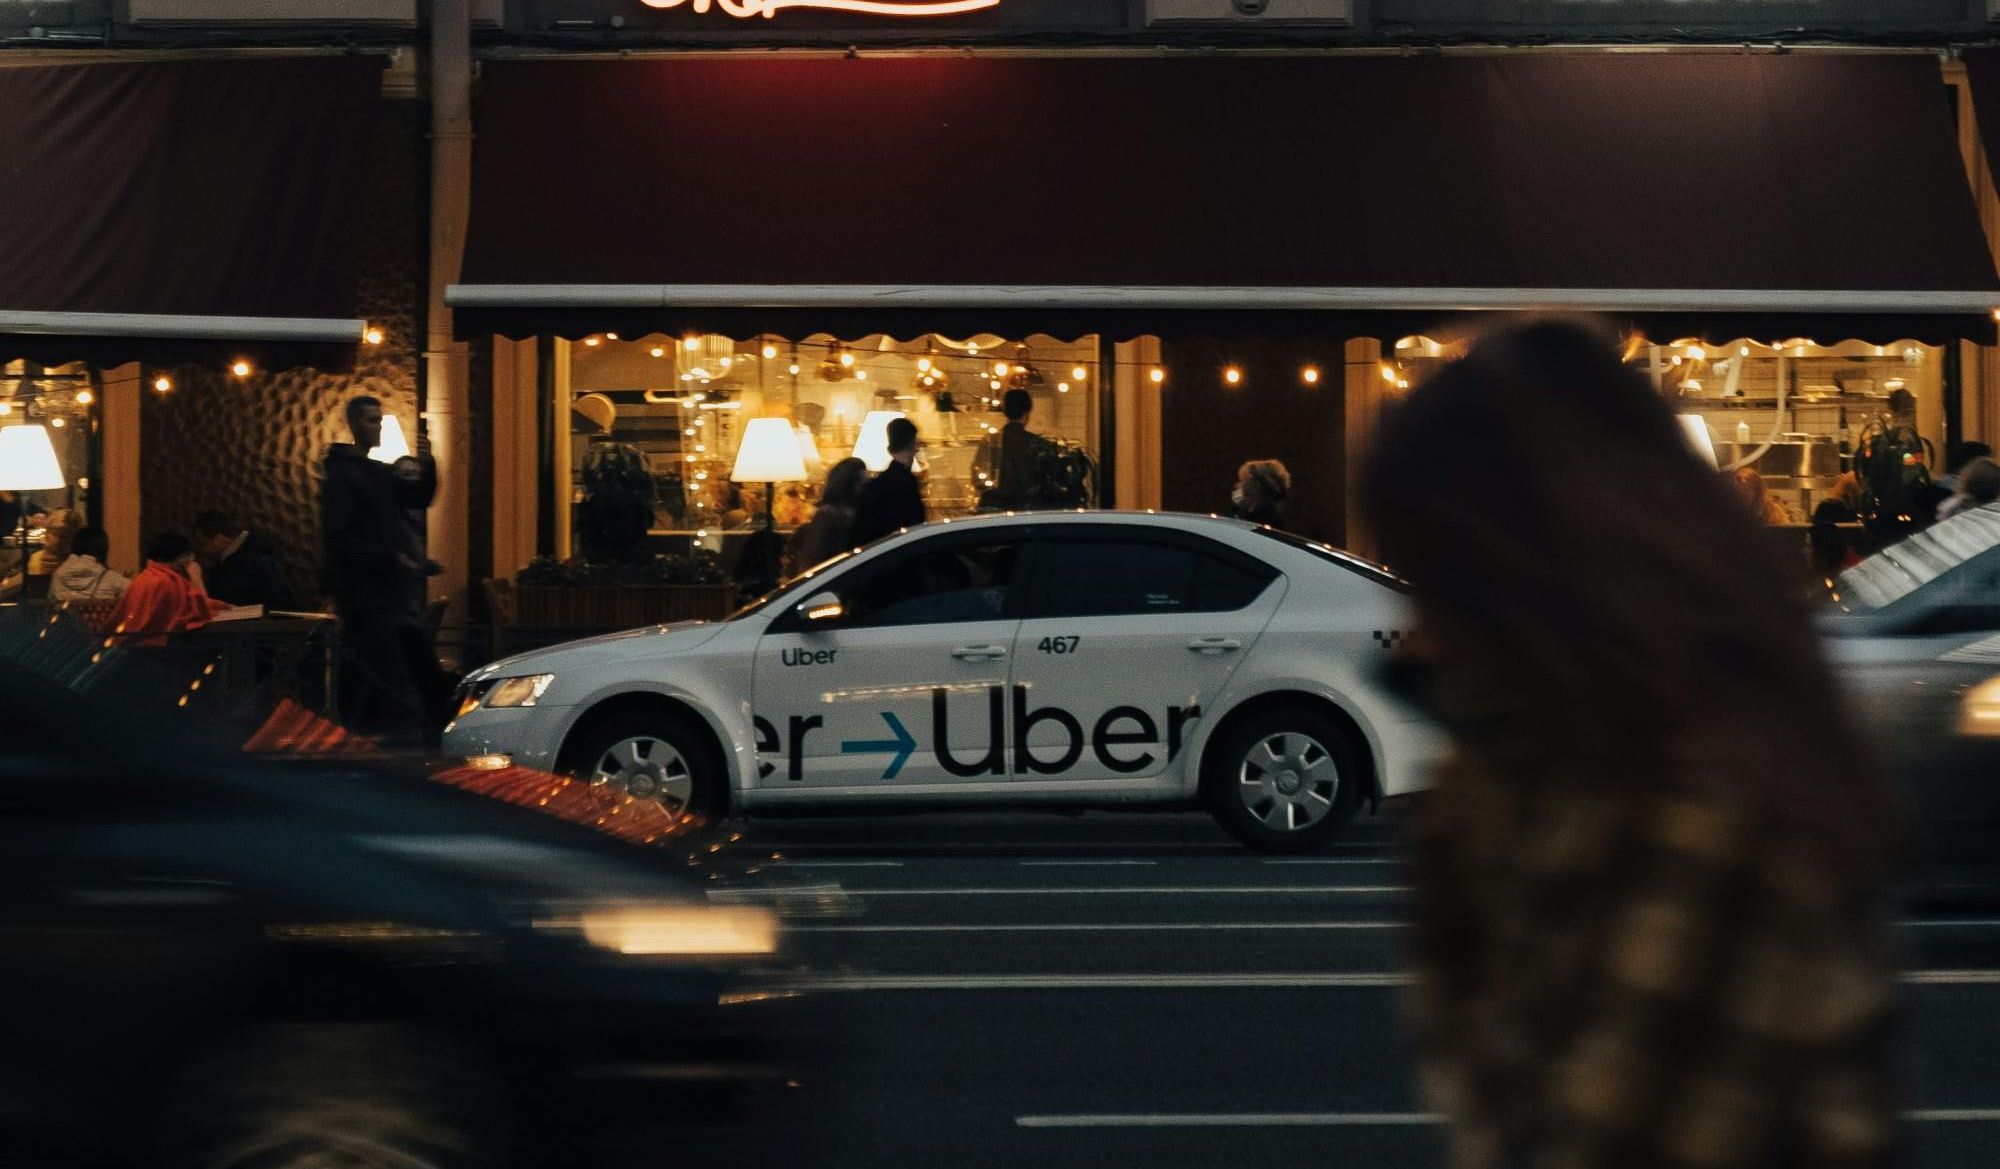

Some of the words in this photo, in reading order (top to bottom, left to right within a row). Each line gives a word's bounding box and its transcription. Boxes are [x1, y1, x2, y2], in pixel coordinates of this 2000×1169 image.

[1037, 636, 1081, 655] 467
[782, 647, 837, 666] Uber
[932, 684, 1201, 777] Uber
